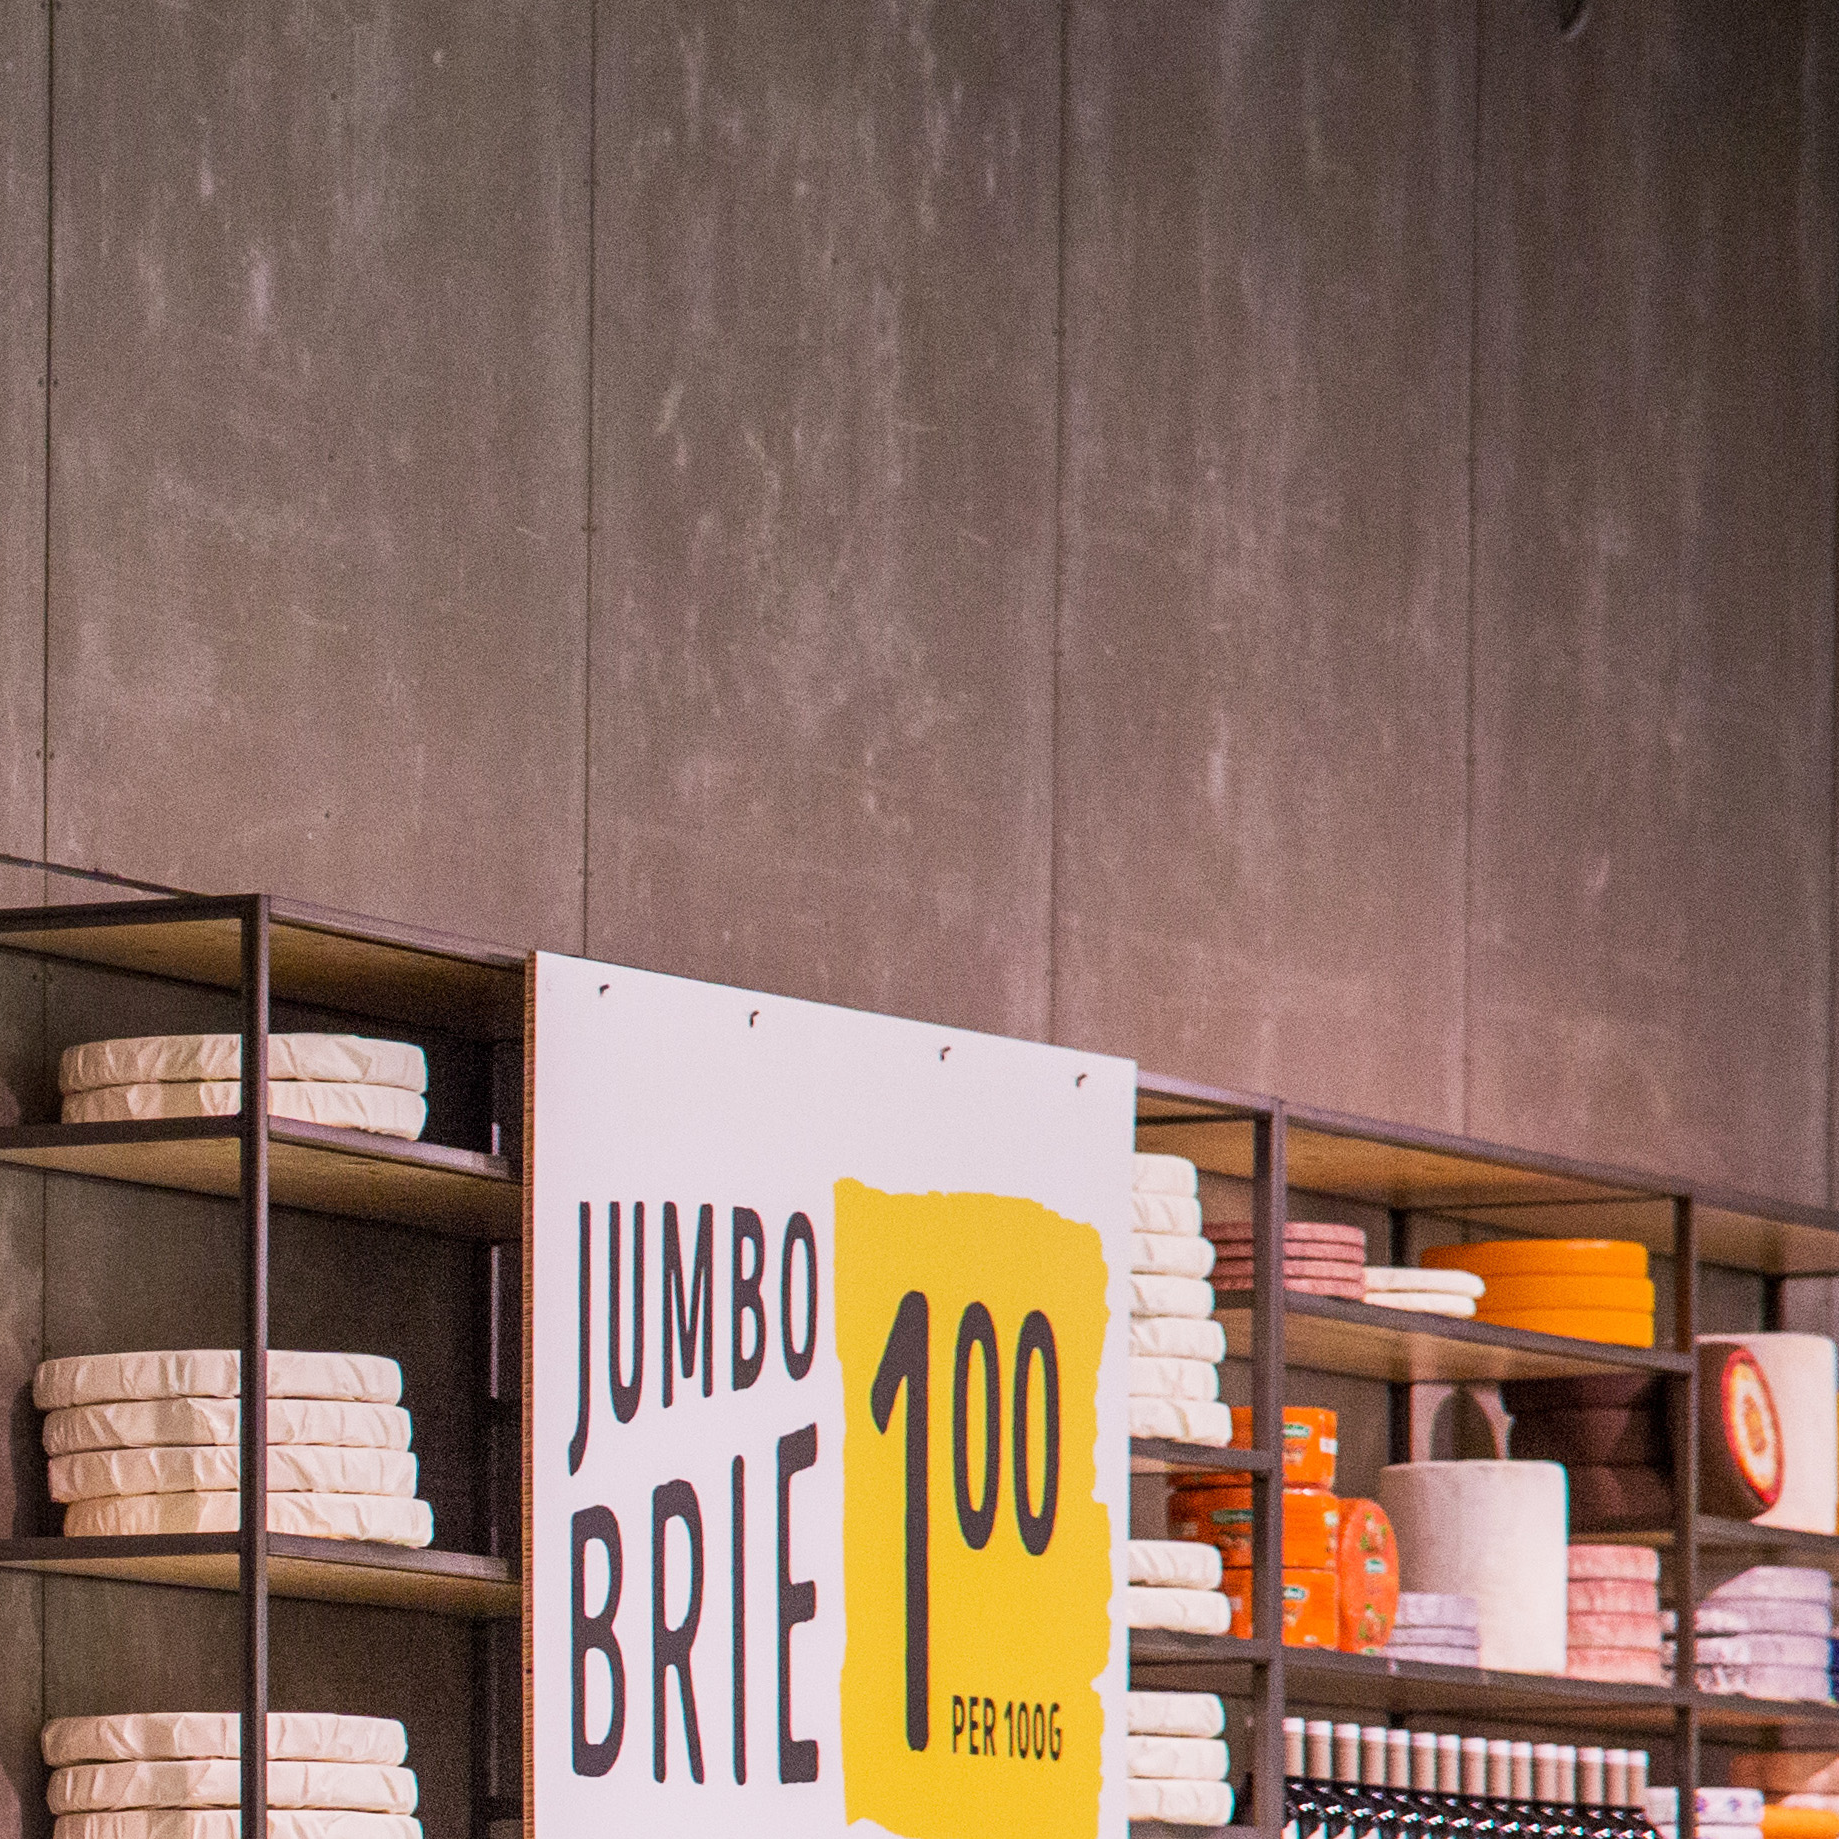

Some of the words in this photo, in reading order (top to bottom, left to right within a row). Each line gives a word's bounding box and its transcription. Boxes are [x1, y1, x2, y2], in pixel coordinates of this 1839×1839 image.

[568, 1201, 818, 1476] JUMBO
[570, 1422, 818, 1785] BRIE
[951, 1695, 998, 1757] PER
[1003, 1700, 1063, 1762] 100G
